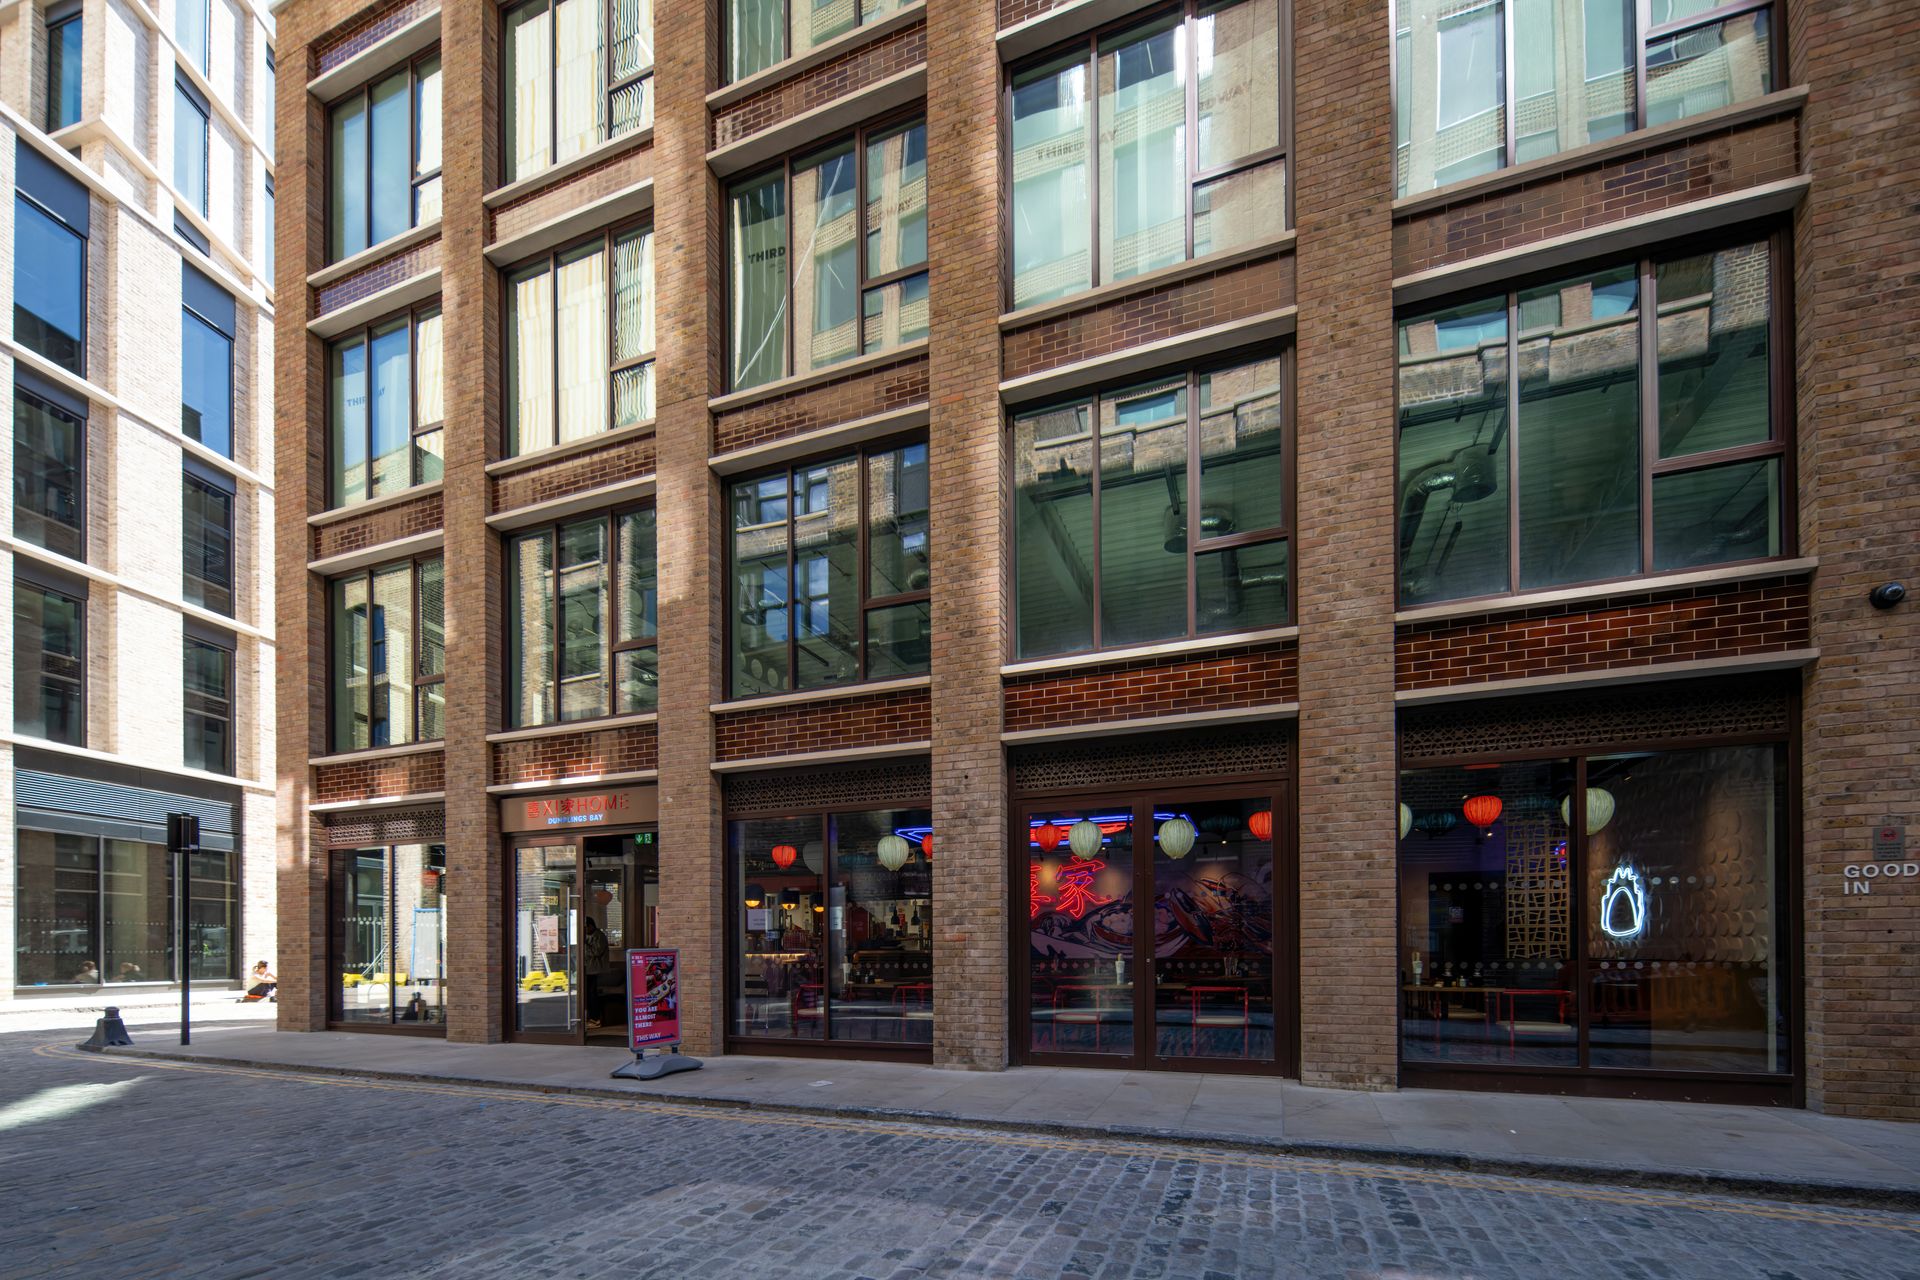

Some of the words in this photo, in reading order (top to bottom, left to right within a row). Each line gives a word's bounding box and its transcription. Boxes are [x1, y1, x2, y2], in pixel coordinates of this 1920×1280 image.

[747, 246, 786, 265] THIRD
[577, 793, 630, 813] HOME
[1843, 863, 1920, 878] GOOD
[1844, 881, 1870, 894] IN
[649, 1032, 661, 1040] WAY
